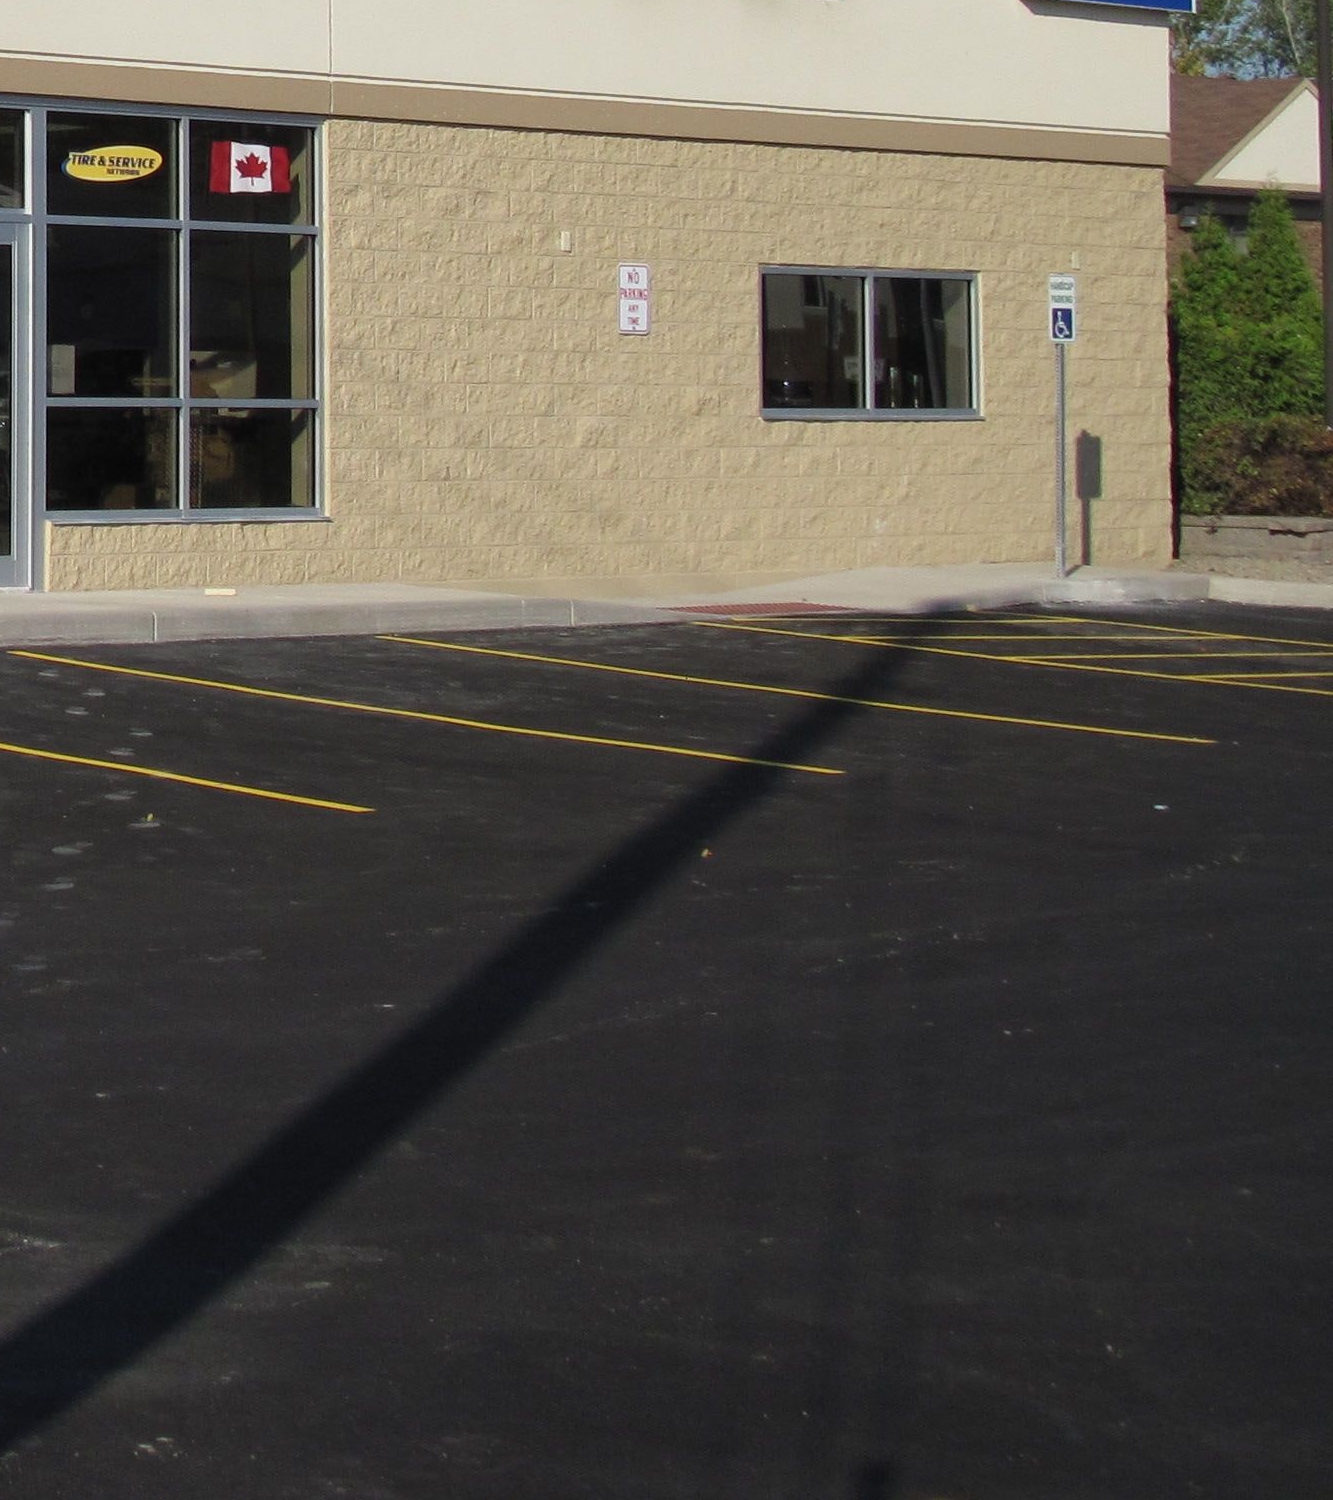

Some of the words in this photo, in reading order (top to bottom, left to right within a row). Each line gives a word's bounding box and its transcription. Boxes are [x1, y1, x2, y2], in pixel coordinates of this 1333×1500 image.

[71, 154, 96, 166] TIRE
[97, 155, 106, 166] &
[107, 156, 156, 169] SERVICE
[627, 272, 640, 284] NO
